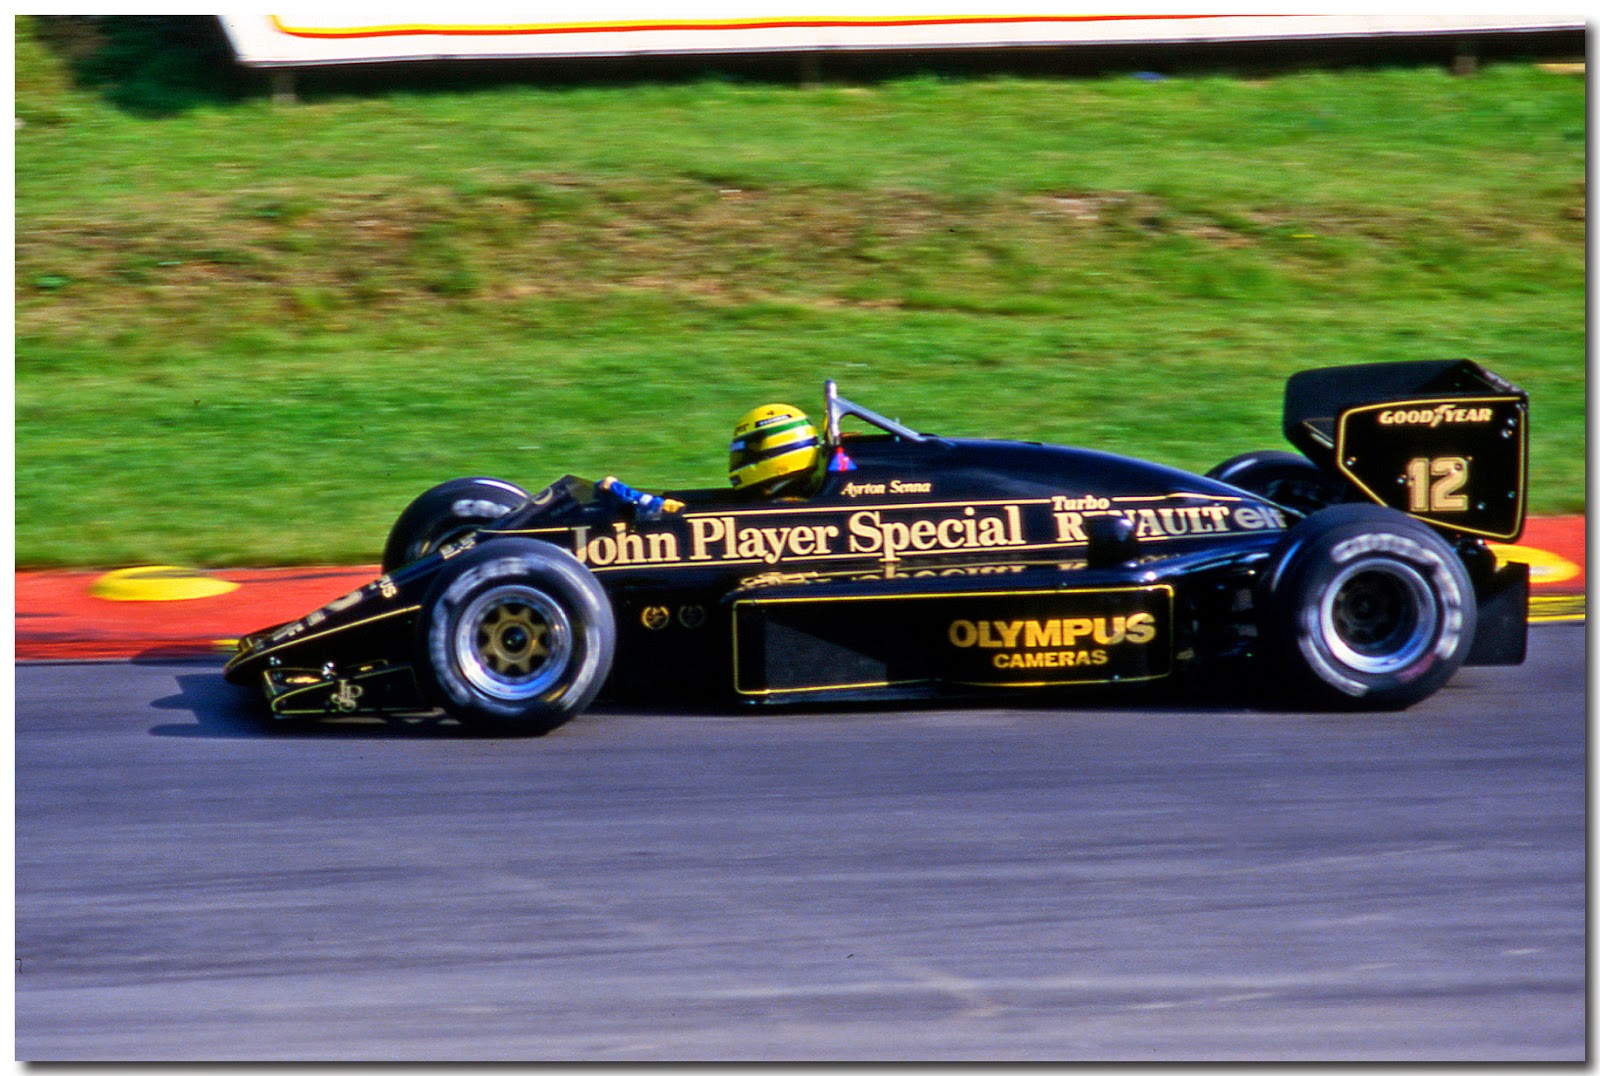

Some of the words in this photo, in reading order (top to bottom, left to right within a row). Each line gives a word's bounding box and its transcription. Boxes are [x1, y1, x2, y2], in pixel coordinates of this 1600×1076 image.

[1379, 404, 1493, 428] GOODYEAR
[841, 482, 886, 498] Ayrton
[889, 480, 932, 493] Senna
[1407, 456, 1469, 512] 12
[1051, 495, 1111, 512] Turbo
[570, 522, 681, 566] John
[687, 517, 839, 564] Player
[848, 506, 1026, 562] Special
[1053, 506, 1231, 542] RAULT
[948, 611, 1157, 649] OLYMPUS
[992, 649, 1109, 669] CAMERAS
